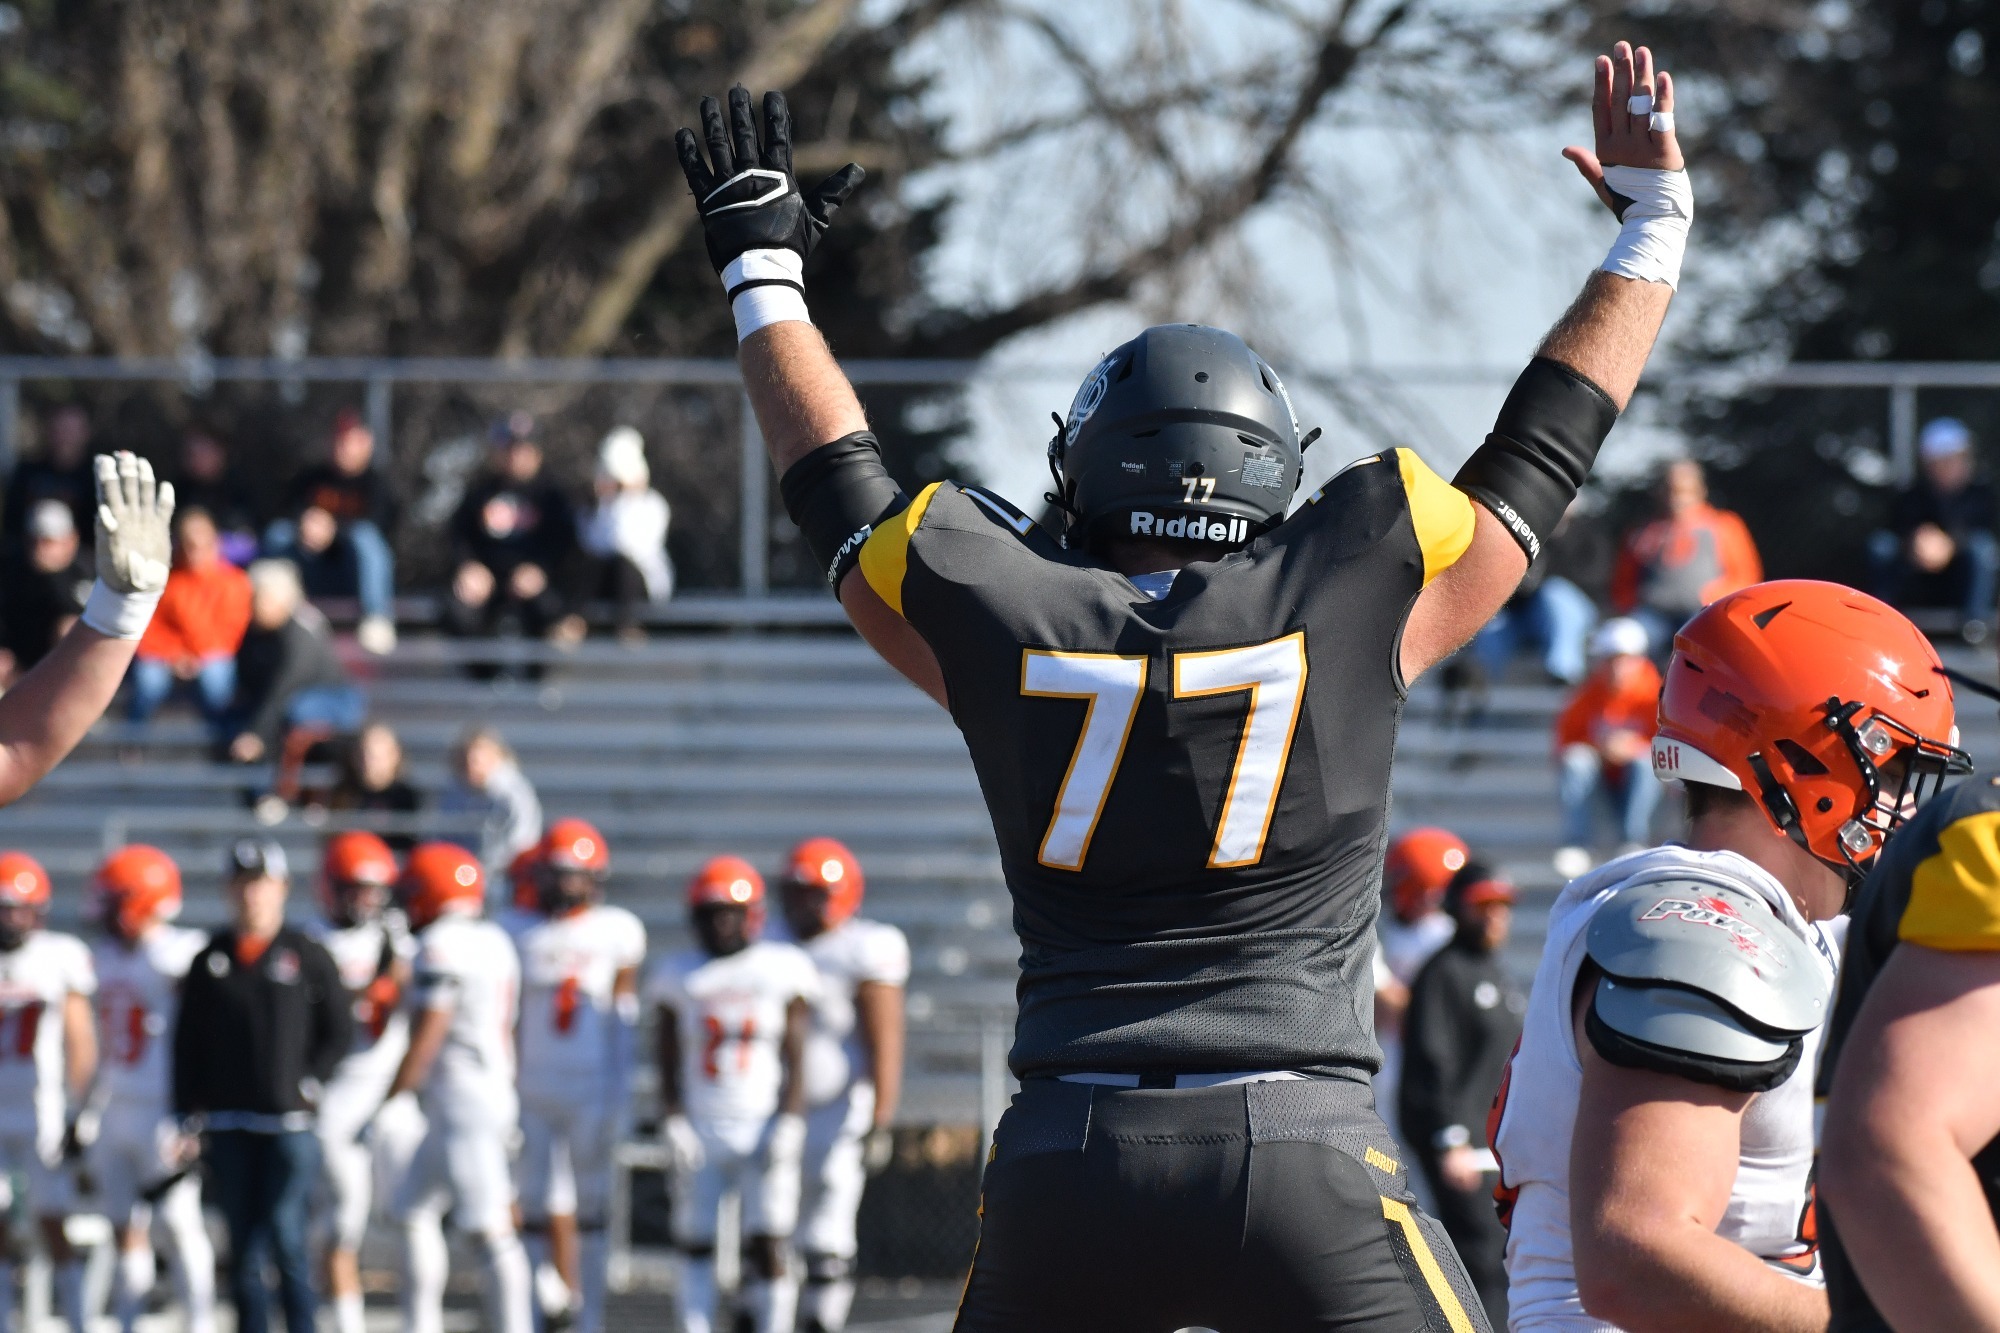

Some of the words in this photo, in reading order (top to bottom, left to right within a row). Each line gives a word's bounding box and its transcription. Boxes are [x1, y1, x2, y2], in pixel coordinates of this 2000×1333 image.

[1181, 477, 1216, 503] 77
[1131, 511, 1248, 543] Riddell
[1019, 631, 1309, 873] 77
